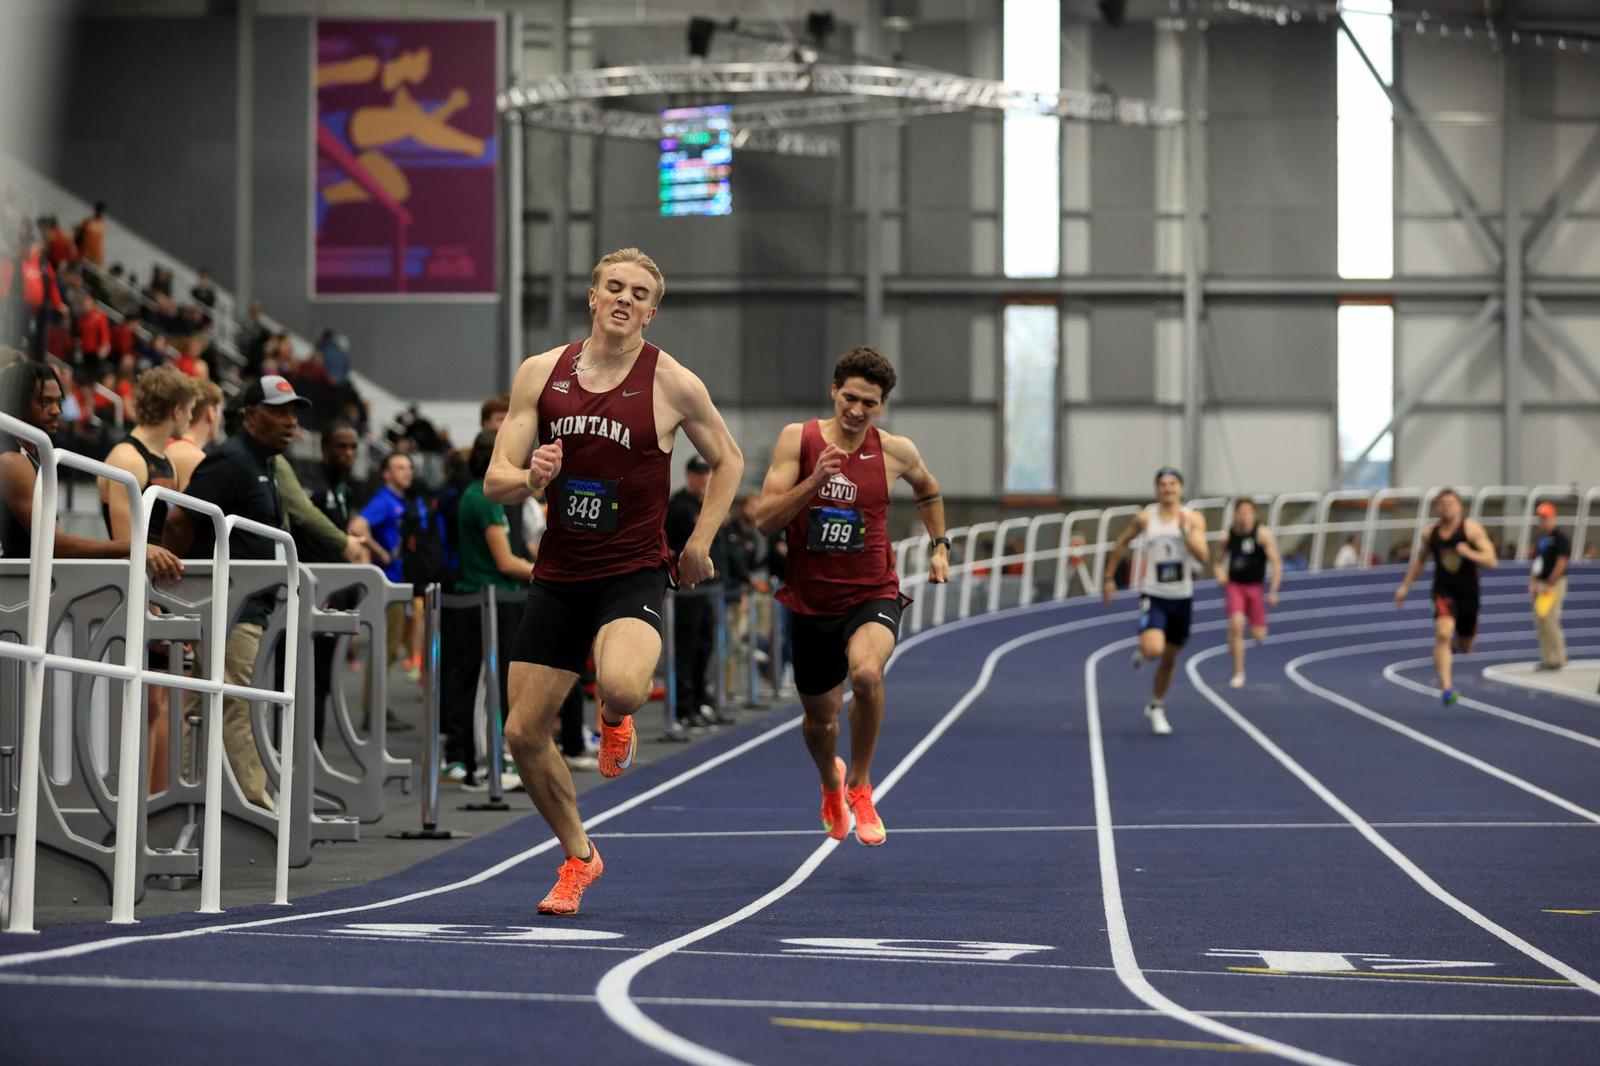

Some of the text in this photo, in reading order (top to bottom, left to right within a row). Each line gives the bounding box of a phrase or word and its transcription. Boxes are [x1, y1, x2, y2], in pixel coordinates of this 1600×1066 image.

[550, 415, 631, 450] MONTANA
[821, 482, 854, 501] CWU
[567, 495, 602, 520] 348
[821, 522, 853, 544] 199
